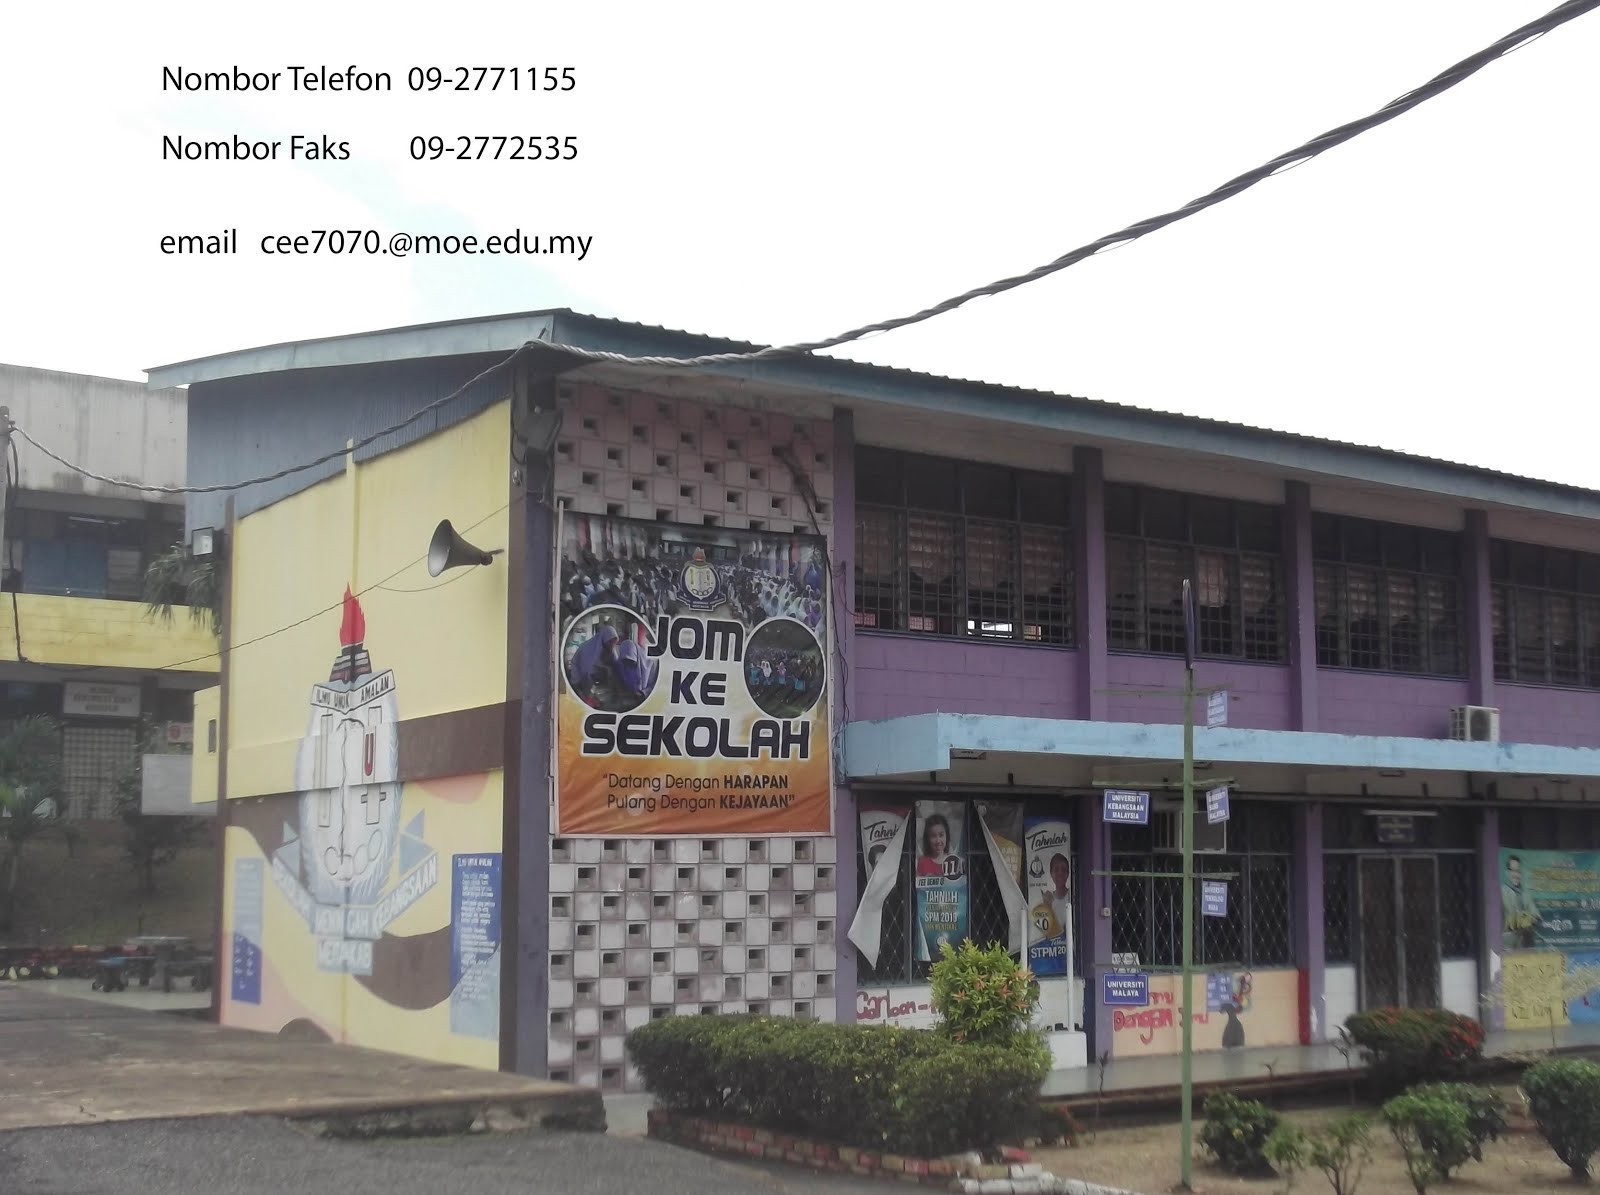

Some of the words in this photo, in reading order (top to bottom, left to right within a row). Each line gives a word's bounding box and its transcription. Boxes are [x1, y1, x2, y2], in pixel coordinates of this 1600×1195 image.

[647, 616, 744, 662] JOM
[360, 675, 389, 702] AMALAN
[670, 670, 727, 705] KE
[583, 713, 810, 759] SEKOLAH
[602, 773, 661, 792] "Datang
[665, 774, 719, 792] Dengan
[723, 775, 788, 789] HARAPAN
[607, 794, 656, 812] Pulang
[660, 794, 716, 813] Dengan
[719, 794, 795, 809] KEJAYAAN"
[1111, 794, 1142, 803] UNIVERSITI
[1107, 802, 1145, 811] KEBANGSAAN
[1112, 811, 1139, 819] MALAYSIA
[1026, 829, 1068, 850] Tahniah
[925, 890, 958, 904] TAHNIAH
[924, 911, 940, 923] SPM
[1030, 947, 1057, 959] STPM
[1107, 980, 1145, 989] UNIVERSITI
[1112, 989, 1139, 997] MALAYA
